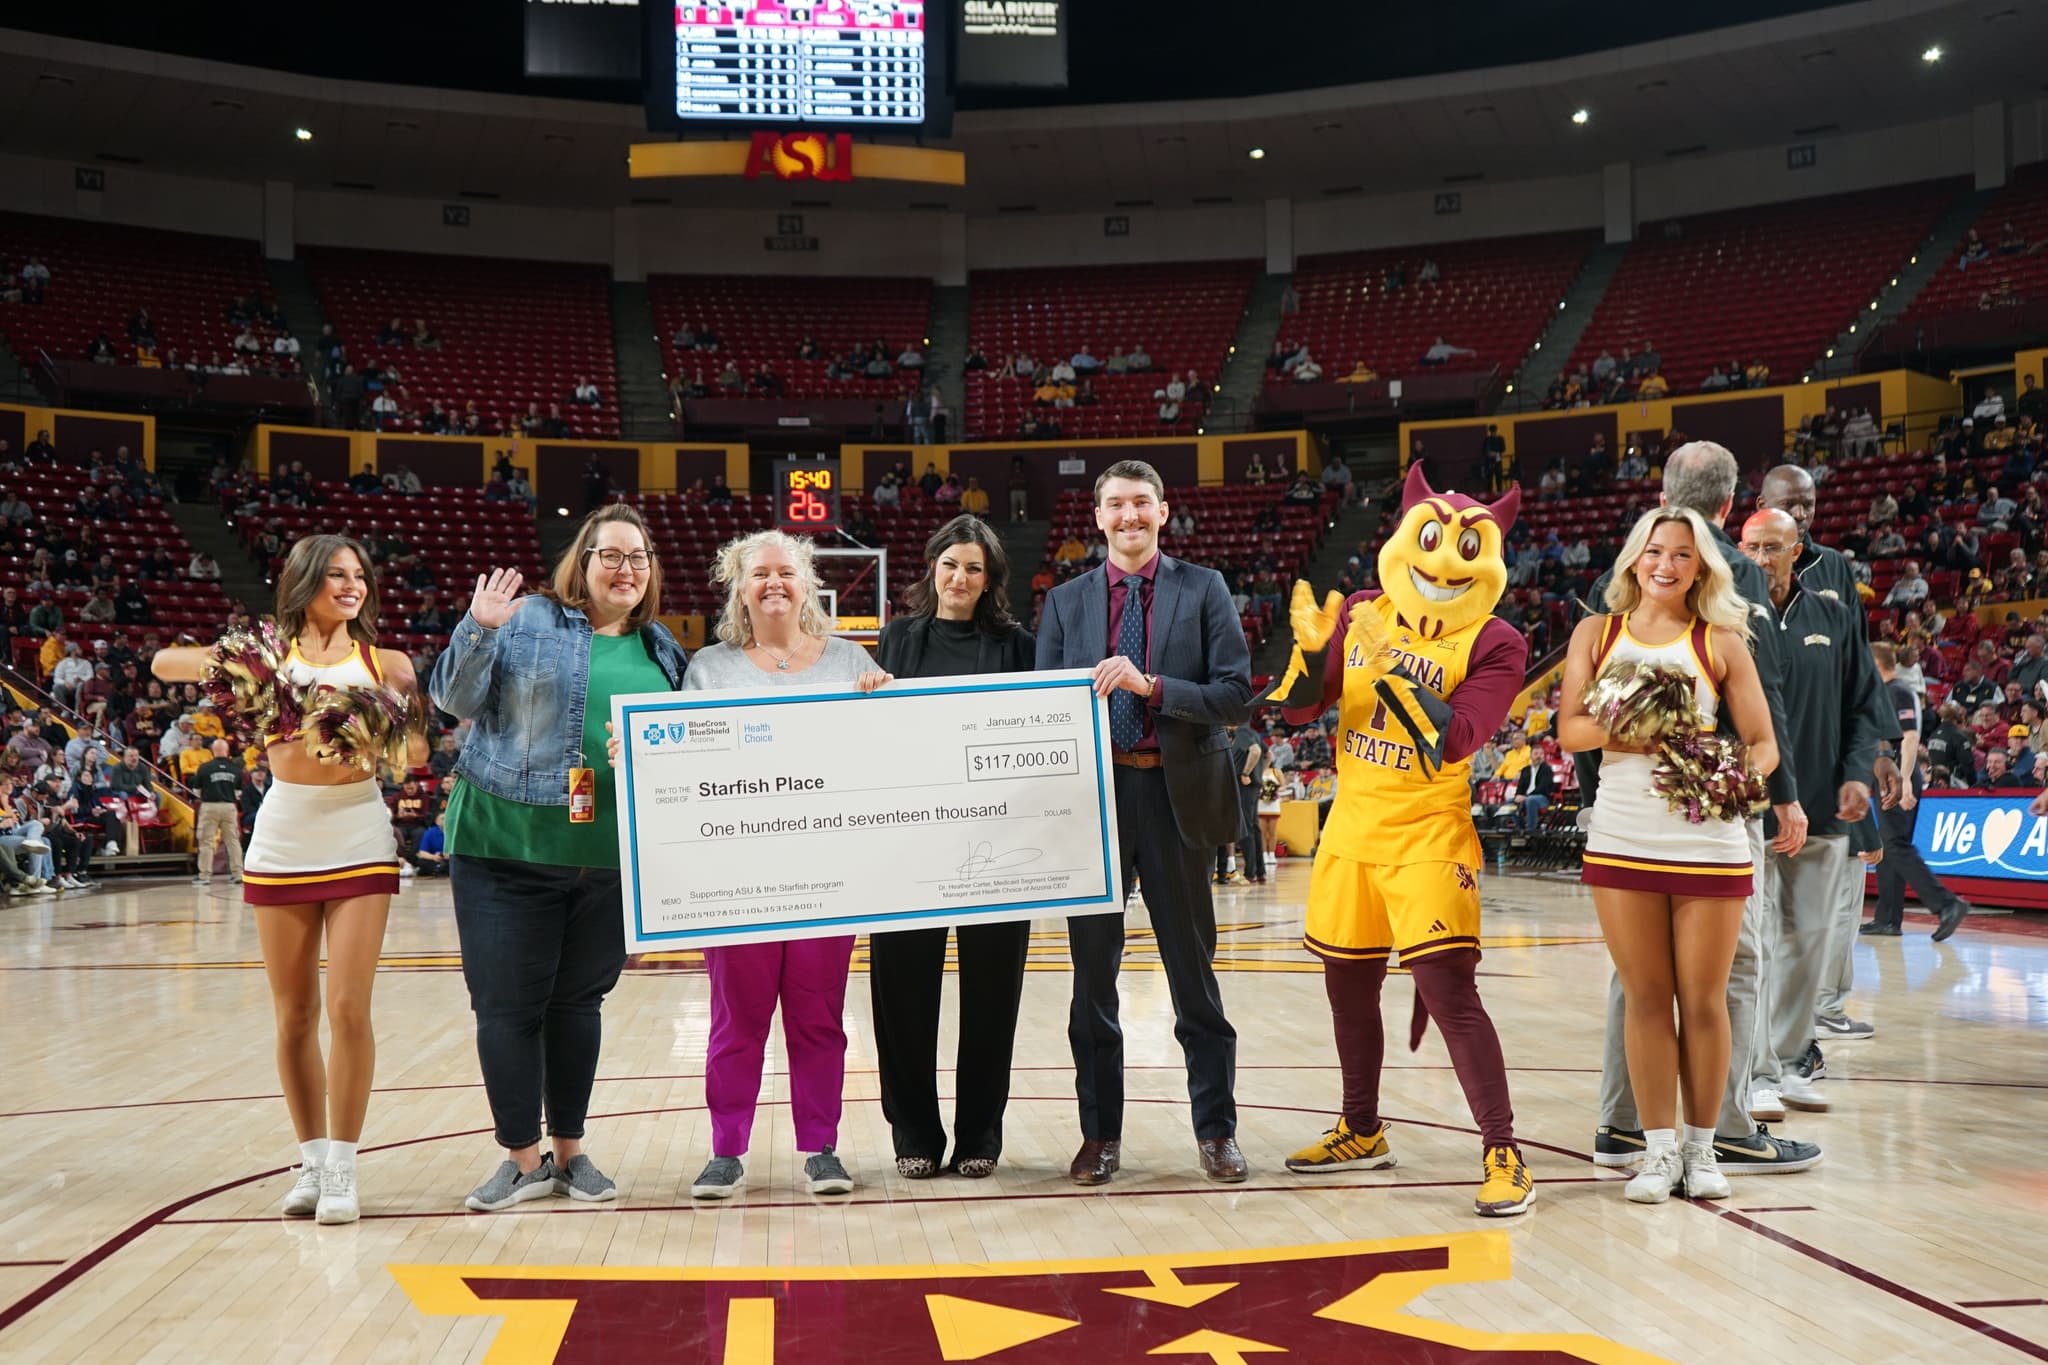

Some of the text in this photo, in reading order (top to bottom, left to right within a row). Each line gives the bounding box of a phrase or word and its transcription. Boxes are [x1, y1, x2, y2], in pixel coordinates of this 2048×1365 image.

[964, 0, 1057, 16] GILA RIVER
[744, 130, 853, 183] ASU
[789, 470, 831, 490] 15:40
[789, 490, 826, 522] 26
[688, 720, 727, 728] BlueCross
[744, 723, 771, 733] Health
[986, 717, 1026, 727] January
[1046, 712, 1072, 723] 2025
[689, 727, 730, 736] BlueShield
[744, 734, 773, 743] Choice
[1344, 729, 1414, 771] STATE
[974, 750, 1069, 771] $117,000.00
[655, 787, 669, 795] PAY
[678, 786, 691, 794] THE
[699, 776, 825, 797] Starfish Place
[655, 797, 680, 805] ORDER
[700, 801, 1008, 838] One hundred and seventeen thousand
[1931, 812, 1976, 854] We
[661, 880, 844, 906] MEMO Supporting ASU & the Starfish program
